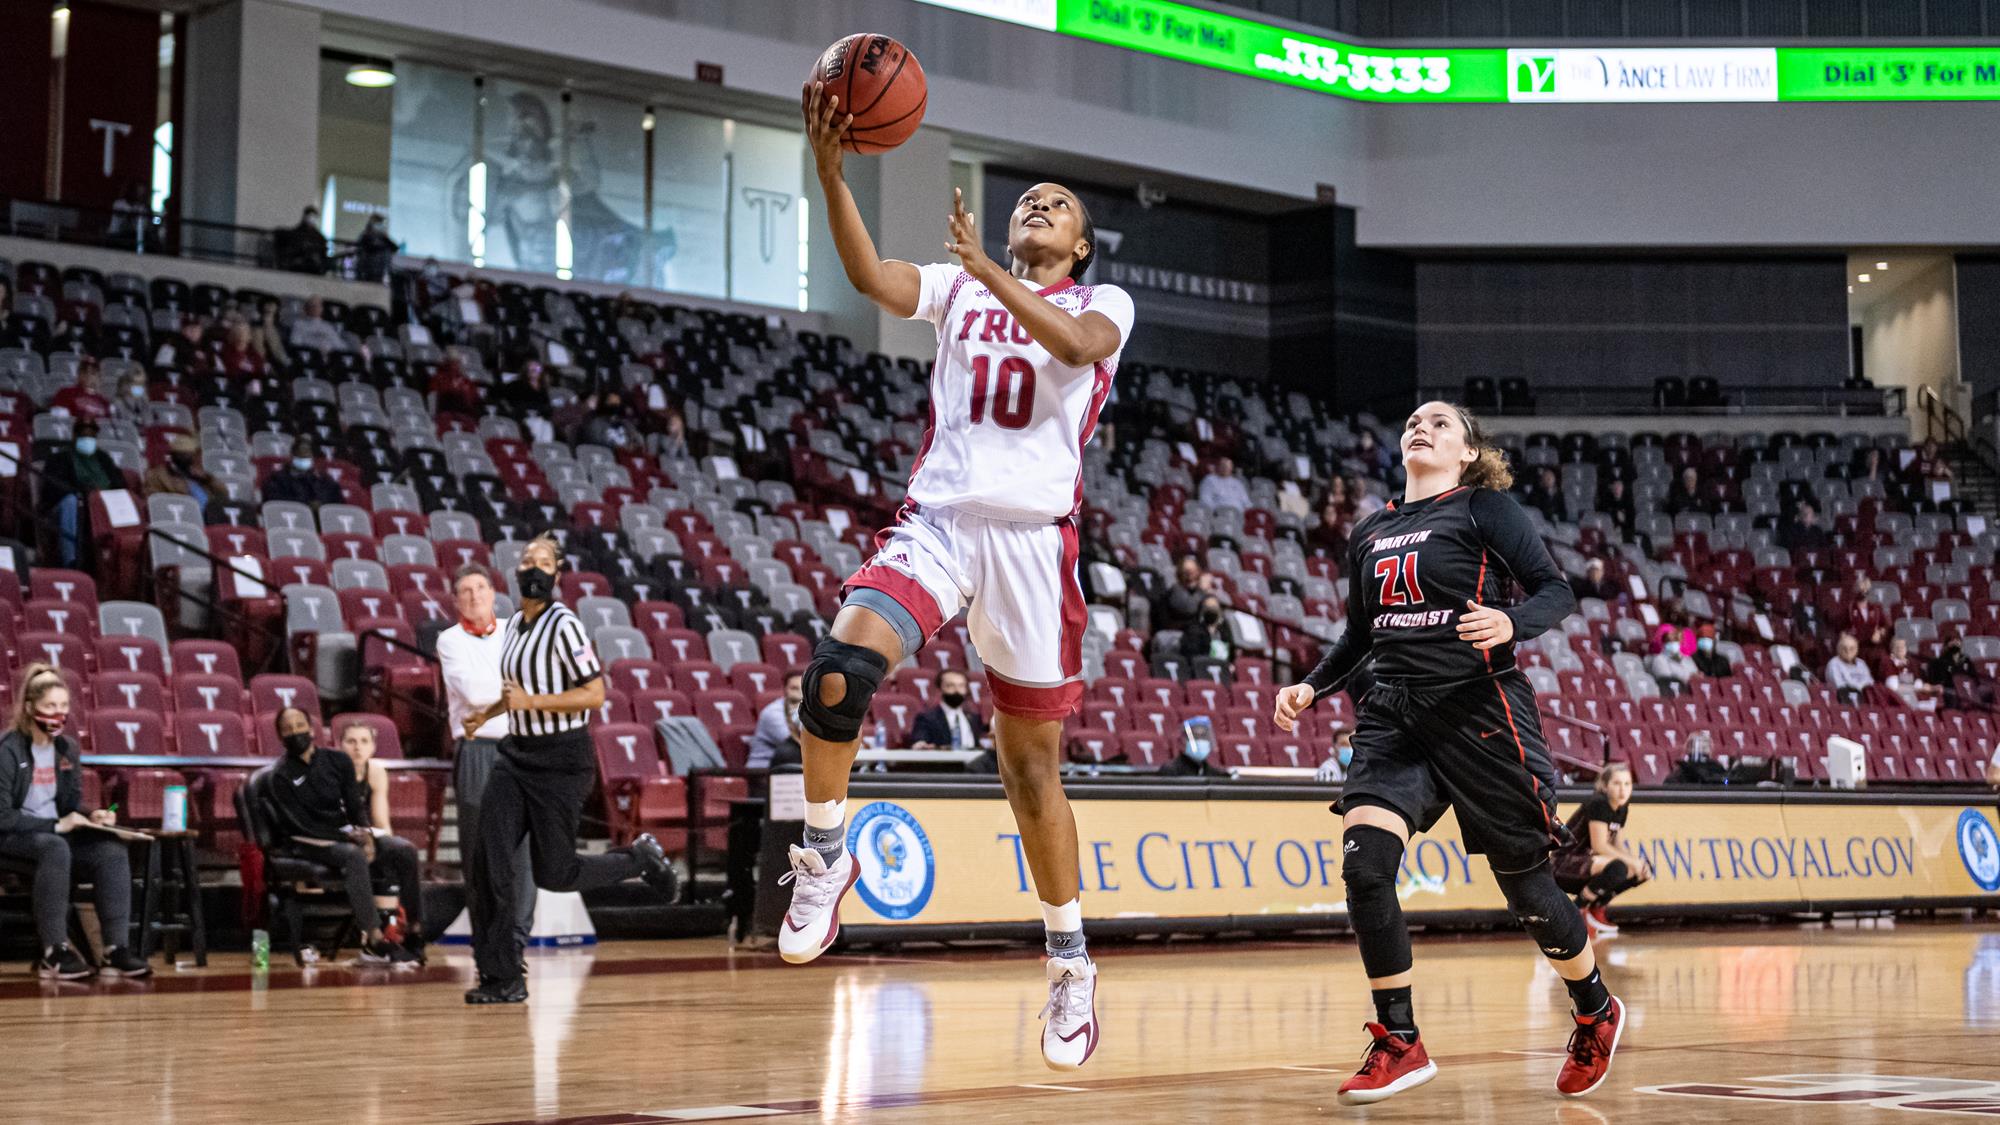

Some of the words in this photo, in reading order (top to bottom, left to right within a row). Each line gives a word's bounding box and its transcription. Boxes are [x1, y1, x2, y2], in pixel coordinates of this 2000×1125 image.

[1165, 16, 1193, 40] For
[1723, 62, 1771, 88] FIRM
[1824, 64, 1875, 83] Dial
[1924, 64, 1965, 82] For
[1974, 64, 2000, 82] M
[1110, 262, 1258, 303] UNIVERSITY
[958, 308, 1034, 346] TRO
[969, 353, 1037, 430] 10
[1371, 529, 1432, 553] MARTIN
[1374, 550, 1425, 606] 21
[997, 833, 1120, 892] TE
[1135, 832, 1256, 891] CITY
[1275, 839, 1335, 888] OF
[1622, 837, 1914, 880] WW.TROYAL.GOV
